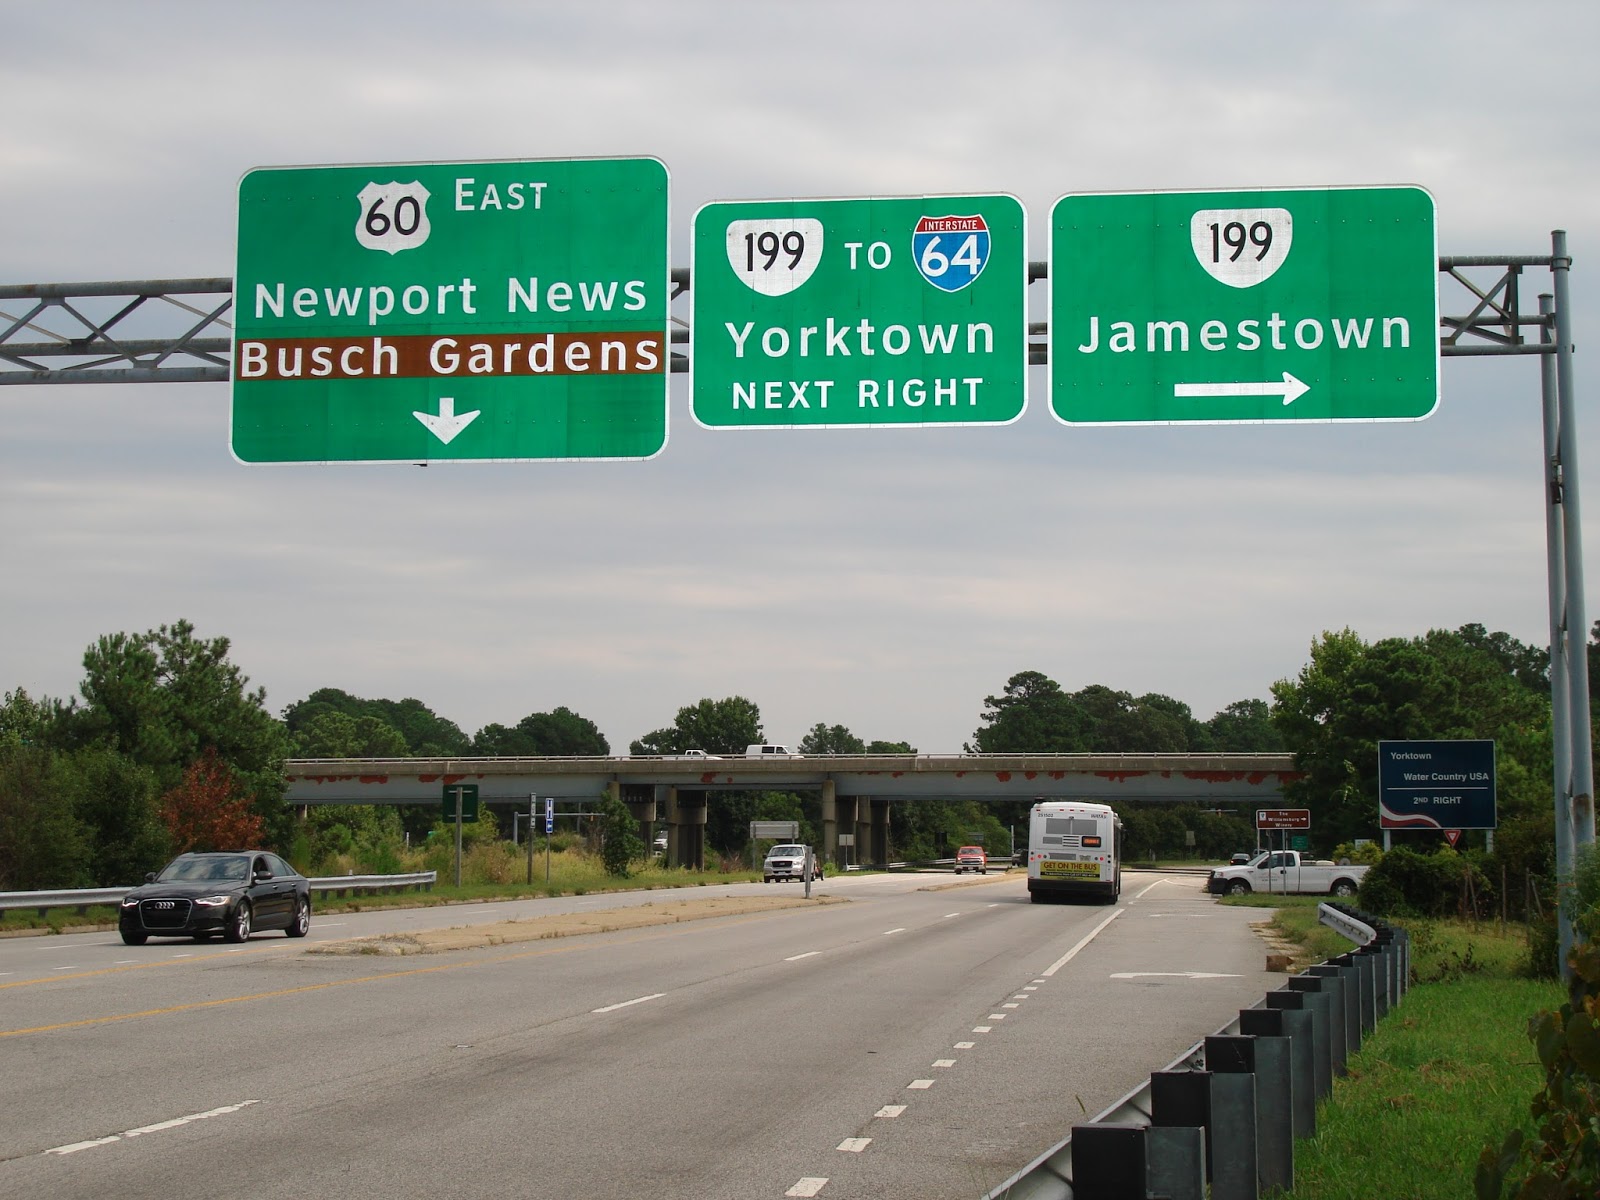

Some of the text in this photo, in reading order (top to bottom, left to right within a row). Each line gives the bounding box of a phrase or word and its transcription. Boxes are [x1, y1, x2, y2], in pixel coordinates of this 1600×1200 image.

[455, 178, 548, 211] EAST
[365, 196, 420, 236] 60
[924, 219, 978, 231] INTERSTATE
[745, 231, 805, 272] 199
[844, 241, 892, 270] TO
[920, 234, 981, 277] 64
[1210, 221, 1273, 263] 199
[255, 277, 646, 325] Newport News
[725, 317, 994, 358] Yorktown
[1078, 312, 1411, 353] Jamestown
[241, 334, 659, 377] Busch Gardens
[732, 378, 983, 409] NEXT RIGHT
[1391, 752, 1432, 760] Yorktown
[1404, 772, 1489, 782] Water Country USA
[1413, 796, 1461, 805] 2ND RIGHT
[1084, 863, 1097, 871] BUS
